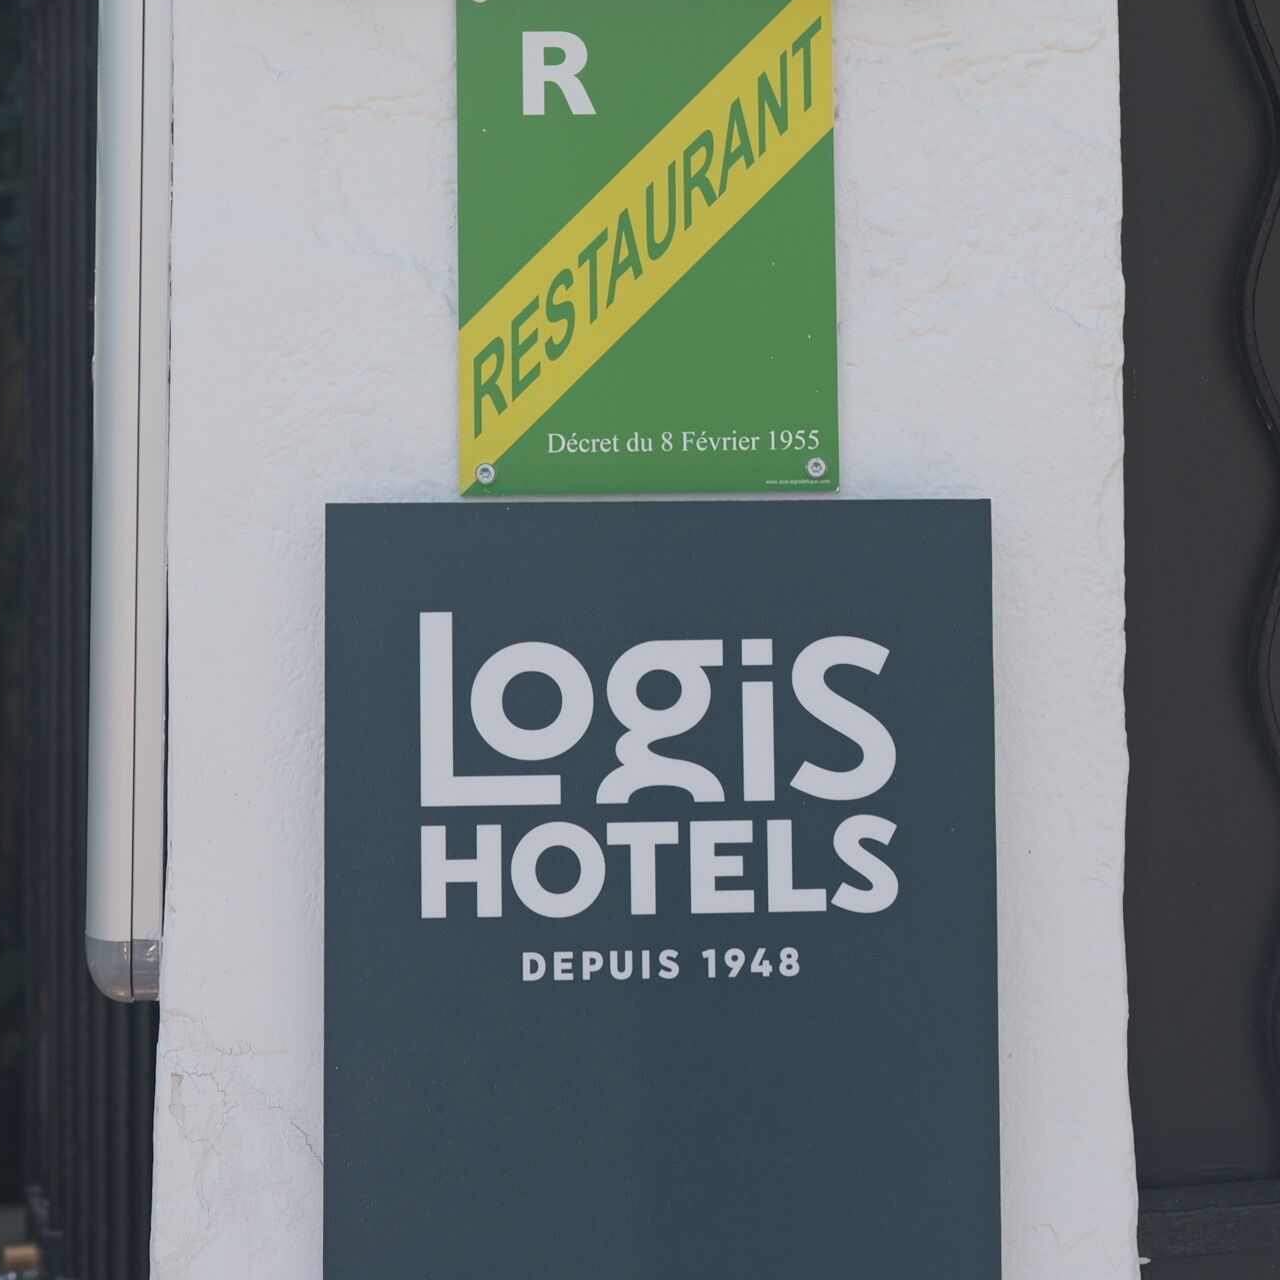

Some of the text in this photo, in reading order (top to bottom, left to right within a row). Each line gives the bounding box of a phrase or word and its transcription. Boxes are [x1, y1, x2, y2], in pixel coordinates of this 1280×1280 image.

[522, 31, 597, 115] R
[473, 15, 822, 440] RESTAURANT
[547, 429, 820, 454] Décret du 8 Février 1955
[420, 814, 899, 919] HOTELS
[522, 947, 801, 981] DEPUIS 1948
